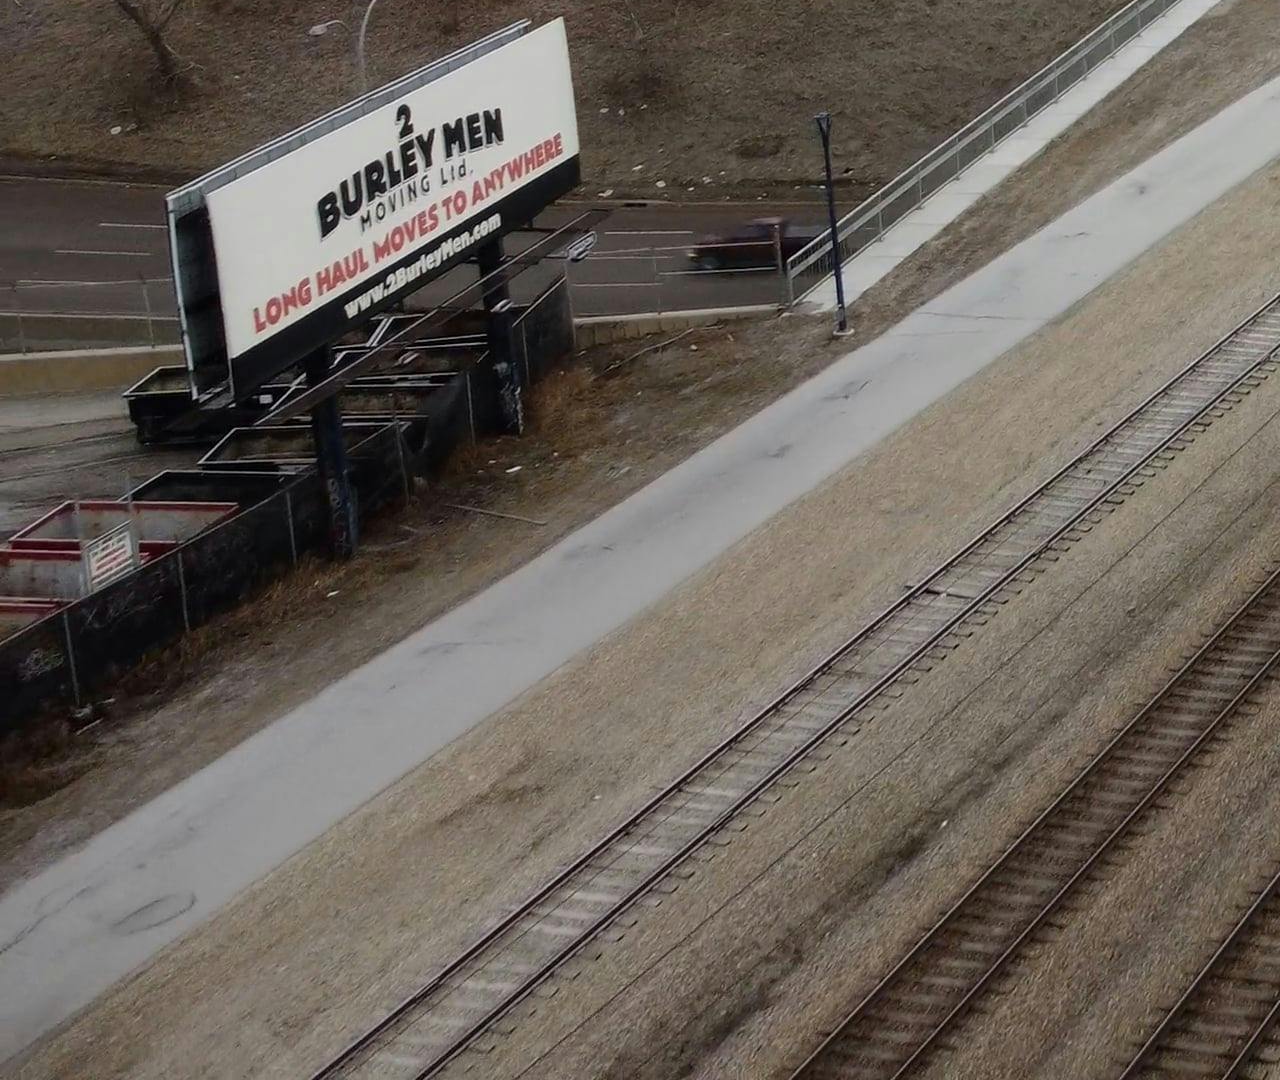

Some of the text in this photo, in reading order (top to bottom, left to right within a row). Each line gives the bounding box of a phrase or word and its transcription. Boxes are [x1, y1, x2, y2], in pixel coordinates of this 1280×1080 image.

[396, 104, 414, 139] 2
[317, 108, 505, 242] BURLEY MEN
[360, 160, 475, 232] MOVING Ltd.
[252, 132, 563, 334] LONG HAUL MOVES TO ANYWHERE
[344, 213, 501, 319] www.2BurleyMen.com
